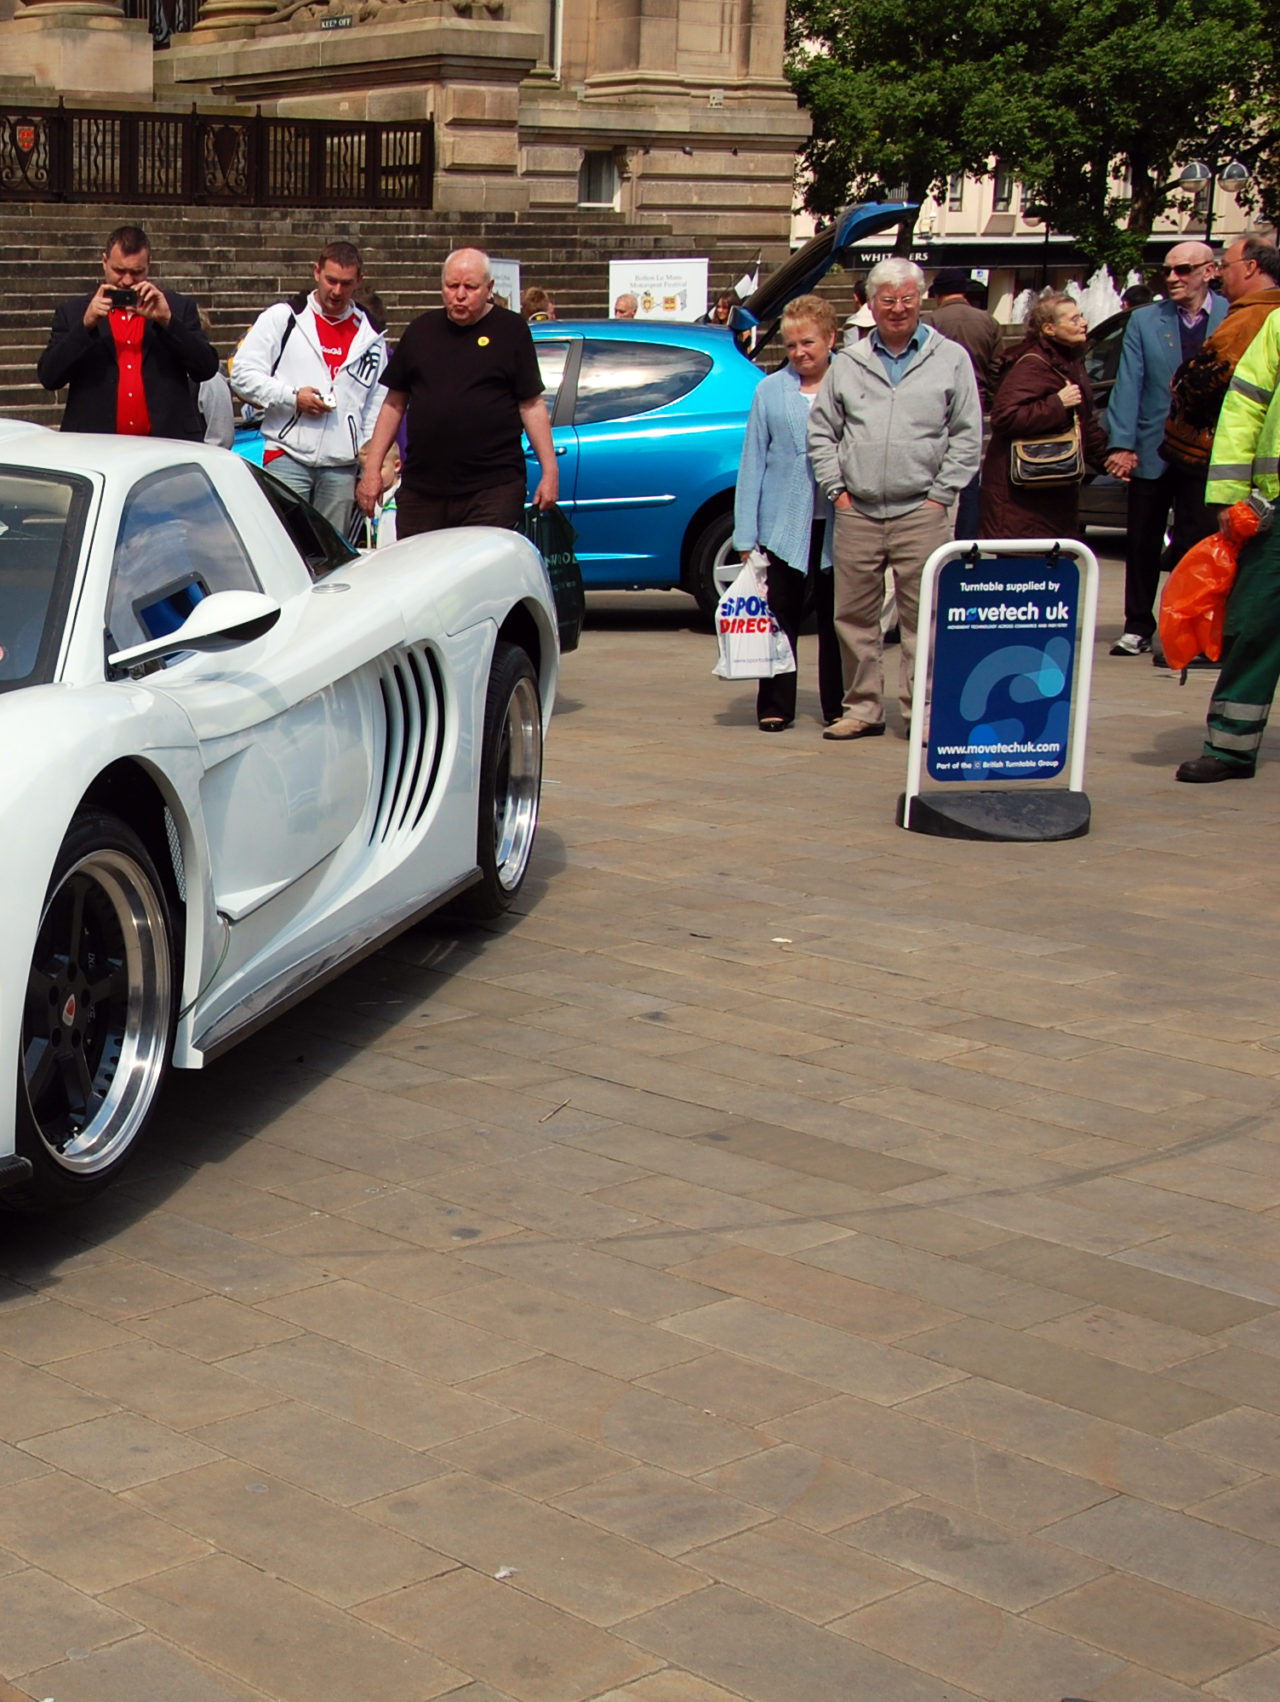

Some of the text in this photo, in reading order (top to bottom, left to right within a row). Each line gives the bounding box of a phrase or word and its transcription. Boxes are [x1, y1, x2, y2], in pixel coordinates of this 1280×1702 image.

[860, 252, 929, 262] WHITERS
[960, 580, 1061, 593] Turntable supplied by
[948, 601, 1069, 622] movetech uk
[720, 618, 773, 634] DIRECT
[937, 741, 1060, 755] www.movetechuk.com
[936, 759, 1059, 770] Part of the British Turntable Group
